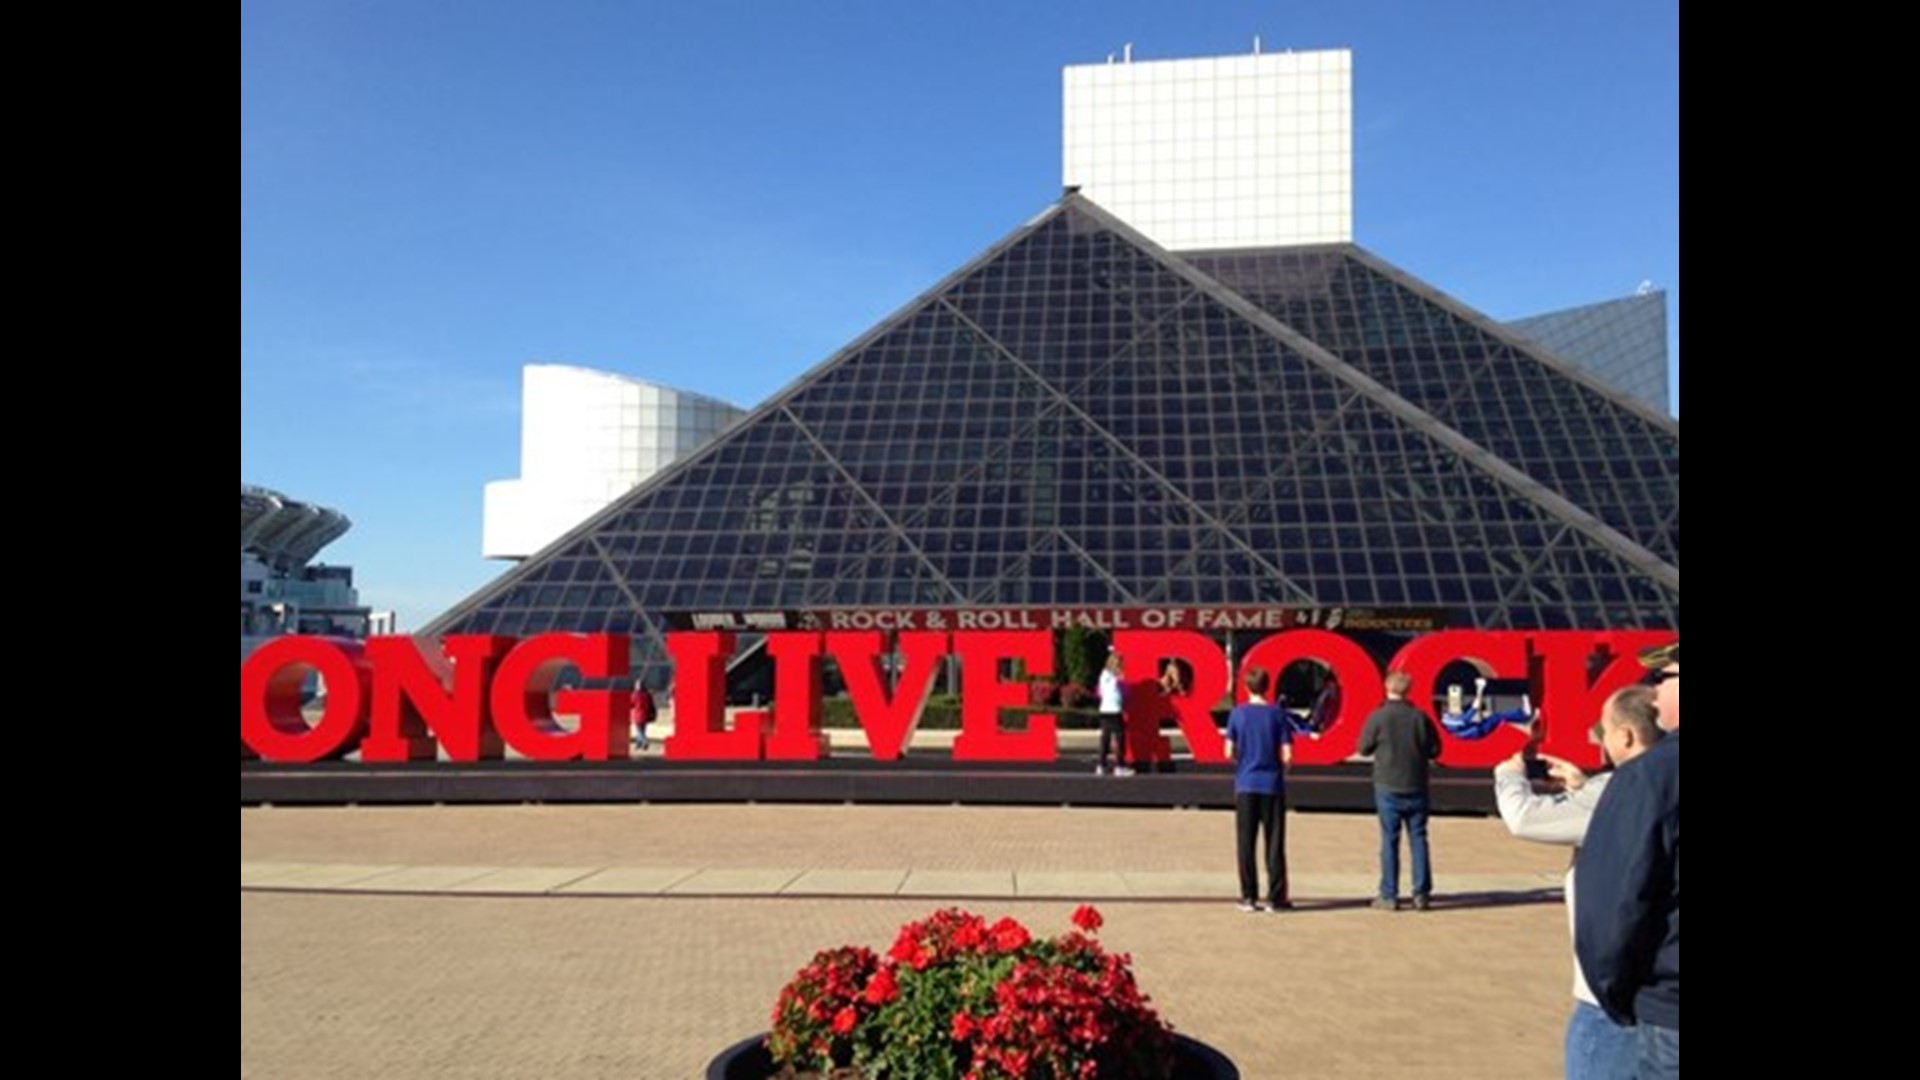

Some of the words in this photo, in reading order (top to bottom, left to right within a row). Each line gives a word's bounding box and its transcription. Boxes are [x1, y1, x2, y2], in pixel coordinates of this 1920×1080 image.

[830, 609, 917, 629] ROCK
[925, 609, 948, 629] &
[956, 609, 1038, 629] ROLL
[1051, 608, 1131, 629] HALL
[1141, 608, 1184, 628] OF
[1199, 608, 1284, 628] FAME
[664, 631, 1058, 761] LIVE
[1112, 629, 1680, 769] ROCK
